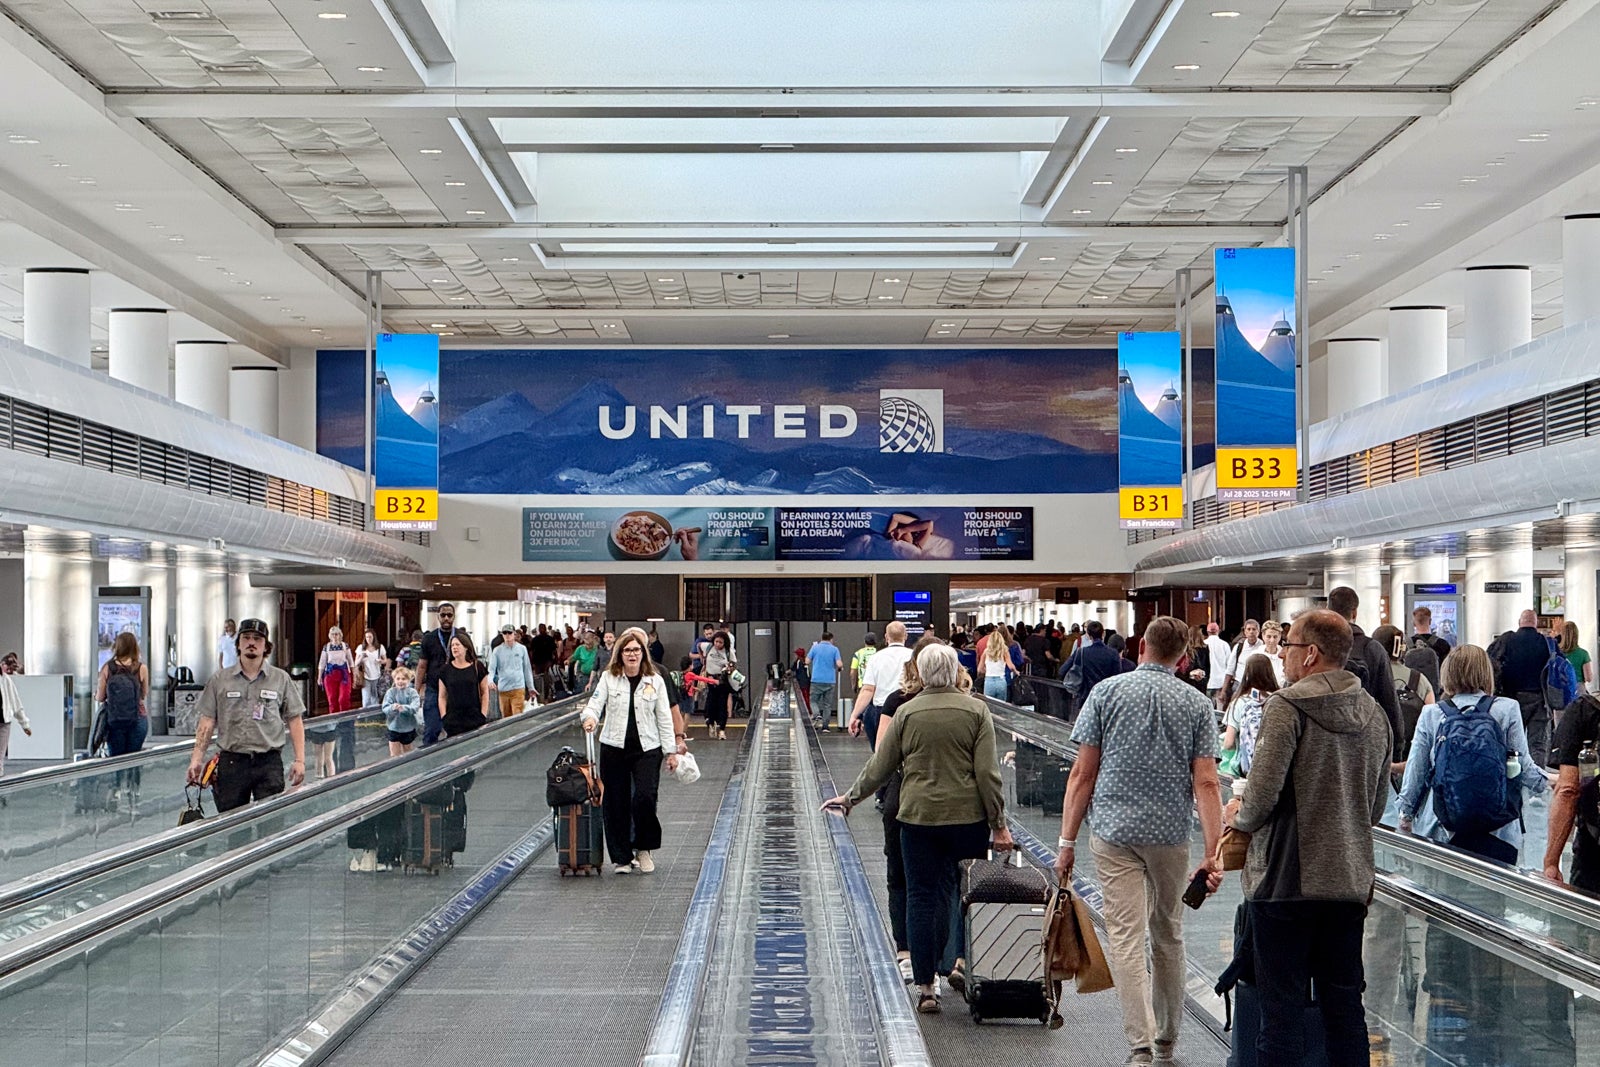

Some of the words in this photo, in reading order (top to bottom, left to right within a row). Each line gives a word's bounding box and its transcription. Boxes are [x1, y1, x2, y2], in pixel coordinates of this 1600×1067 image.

[598, 404, 858, 440] UNITED
[1231, 458, 1282, 480] B33
[1223, 490, 1232, 498] Jul
[386, 497, 426, 513] B32
[1132, 495, 1169, 512] B31
[530, 512, 537, 520] IF
[538, 512, 557, 520] YOU
[558, 512, 584, 520] WANT
[809, 529, 845, 538] DREAM,
